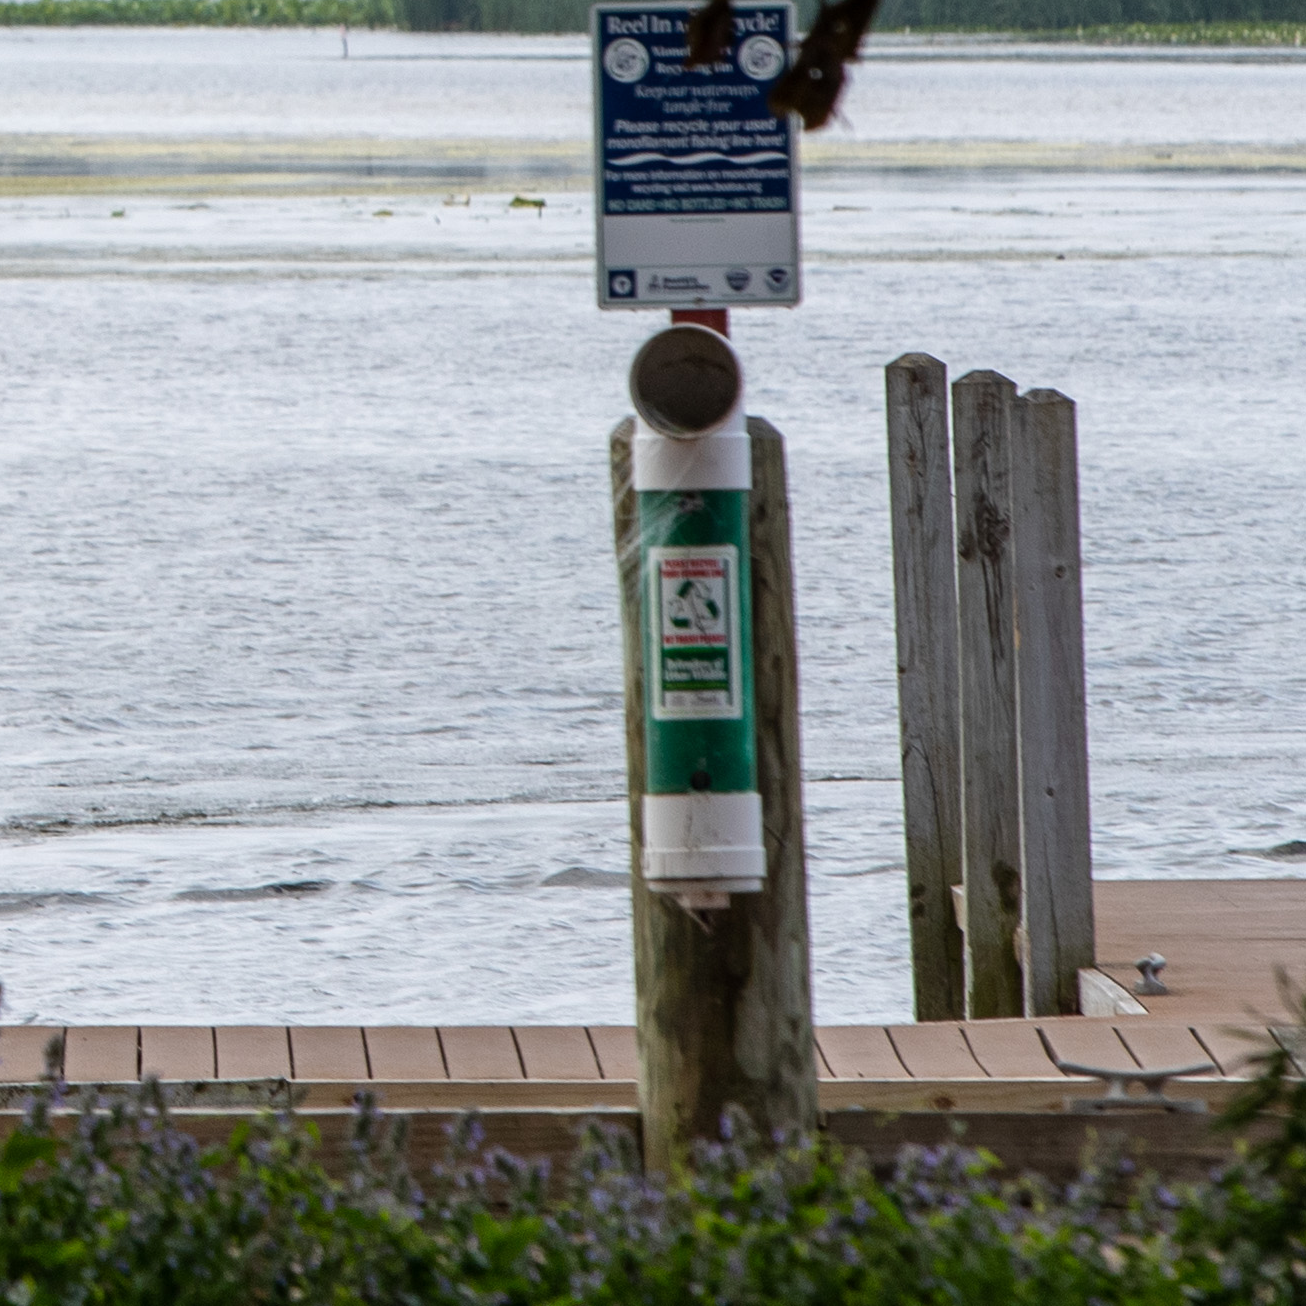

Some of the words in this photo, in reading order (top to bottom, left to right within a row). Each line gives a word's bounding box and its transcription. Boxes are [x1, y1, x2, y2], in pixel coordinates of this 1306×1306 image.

[607, 15, 648, 35] Reel
[651, 16, 672, 34] In
[615, 118, 660, 134] Please
